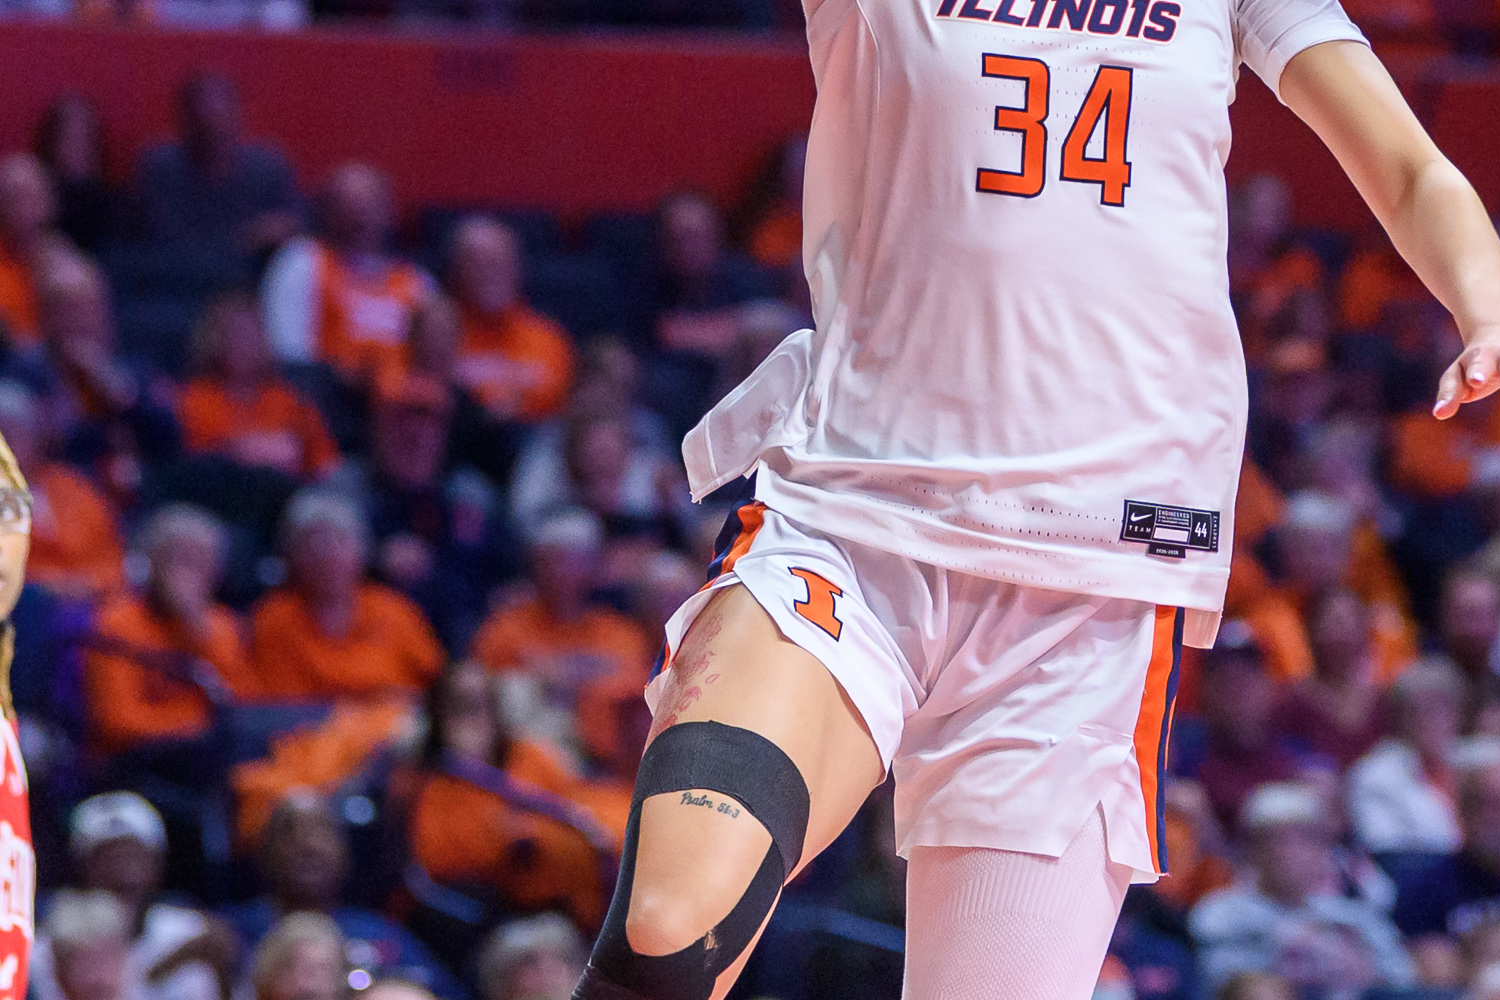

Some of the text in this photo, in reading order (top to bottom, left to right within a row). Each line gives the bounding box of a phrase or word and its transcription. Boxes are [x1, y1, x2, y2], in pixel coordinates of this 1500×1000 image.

[975, 52, 1134, 208] 34
[1195, 522, 1207, 537] 44
[680, 791, 740, 818] Psalm 56:3
